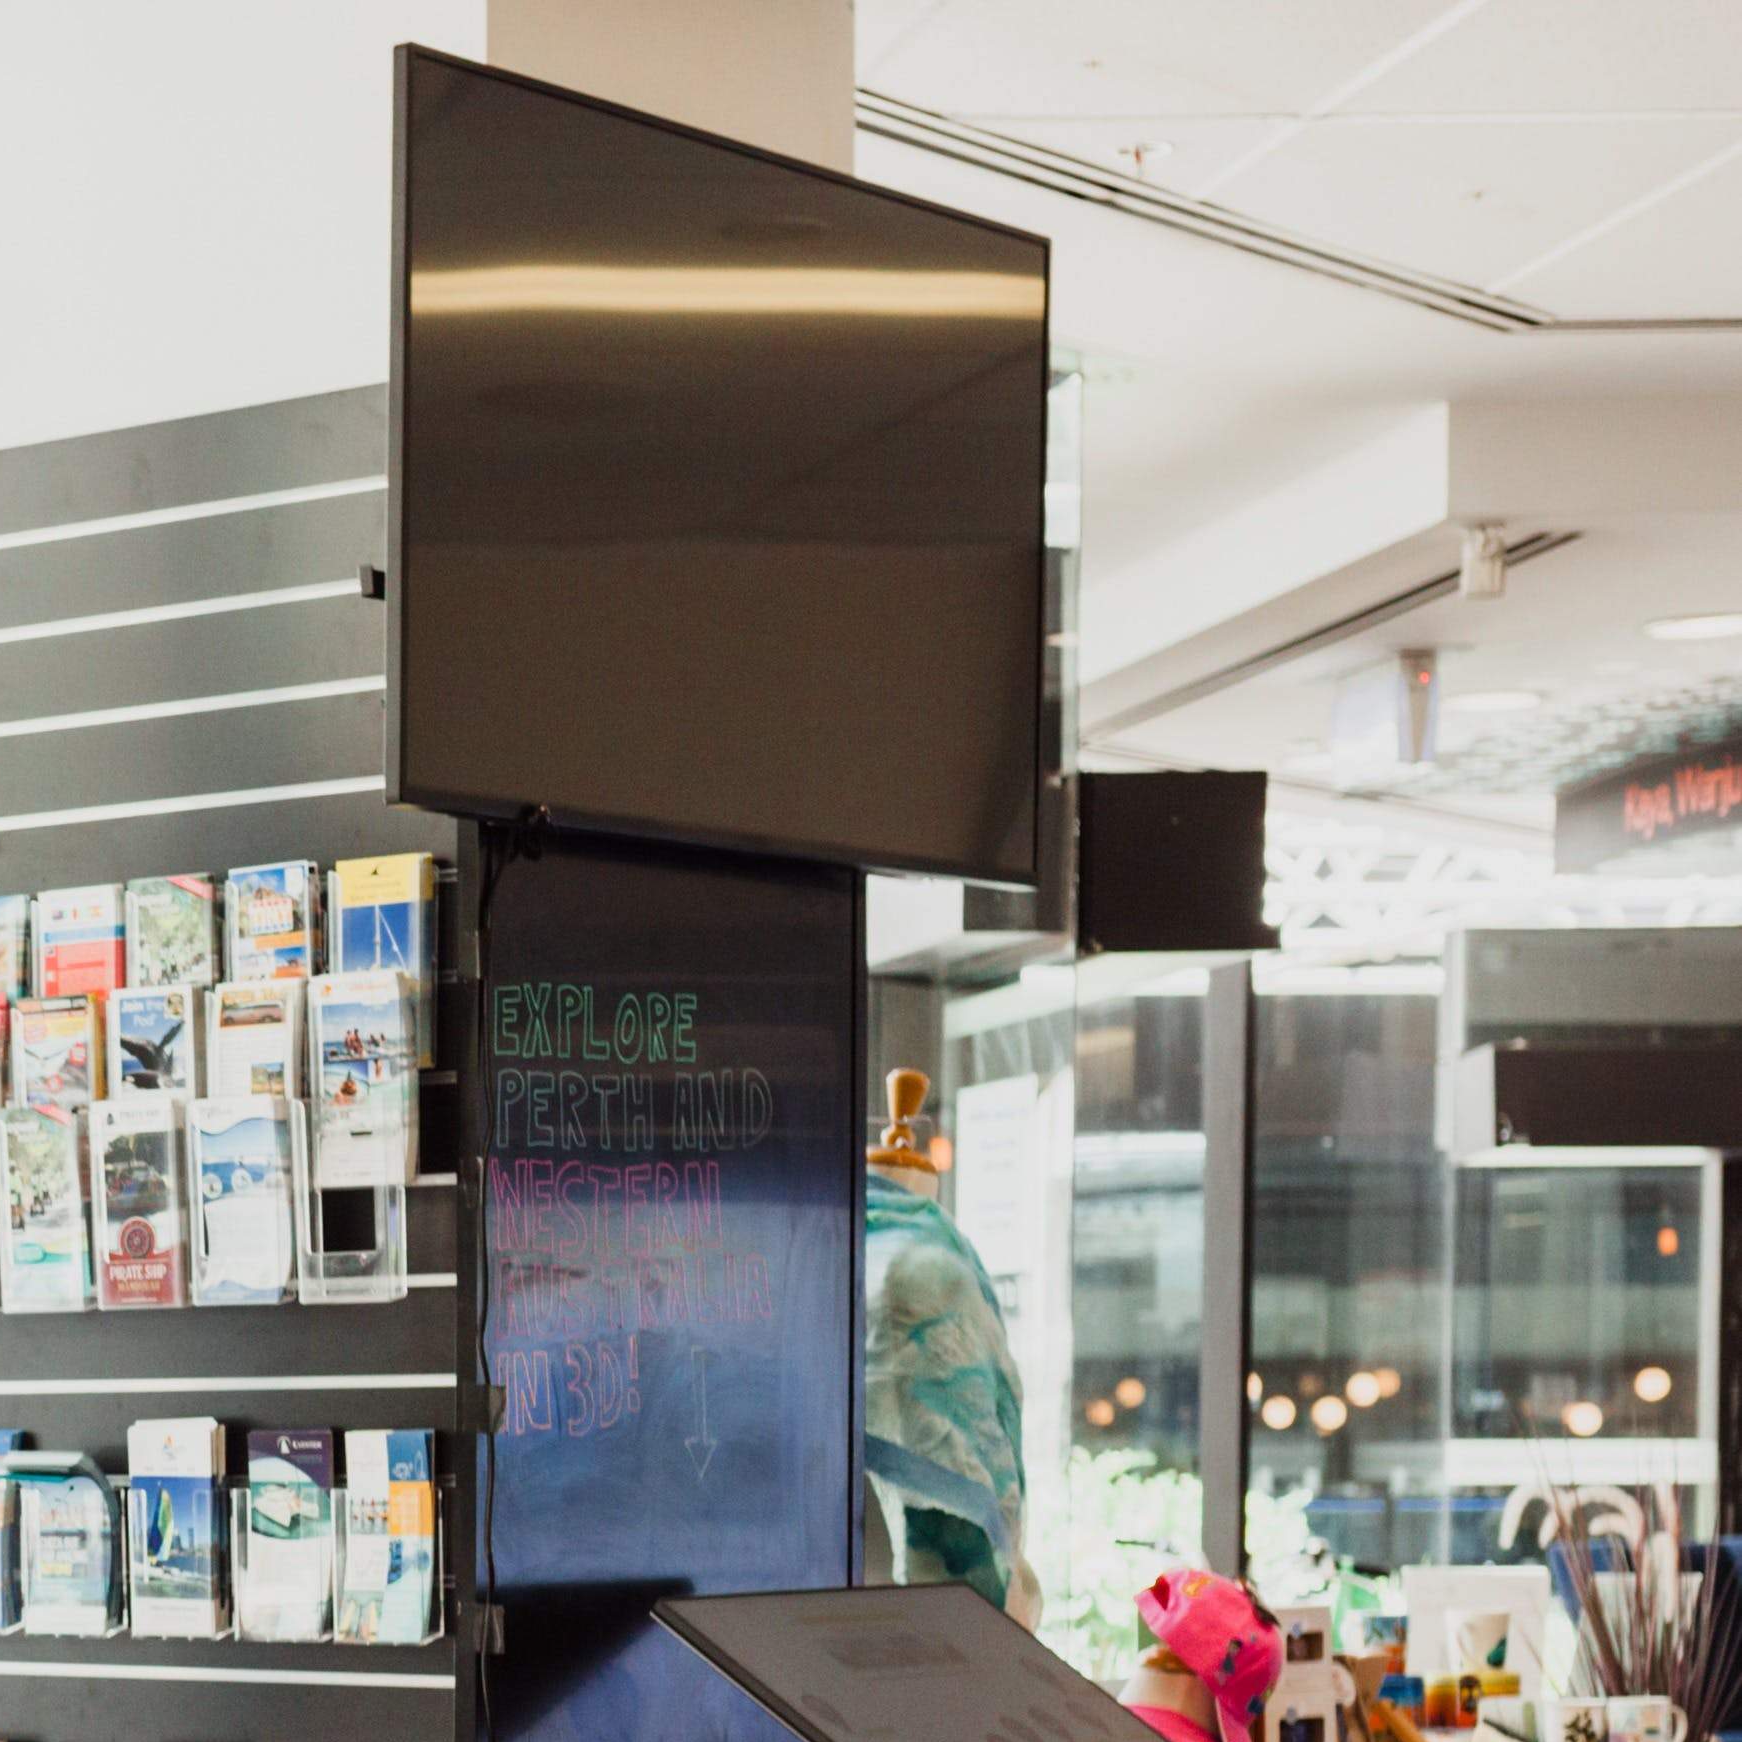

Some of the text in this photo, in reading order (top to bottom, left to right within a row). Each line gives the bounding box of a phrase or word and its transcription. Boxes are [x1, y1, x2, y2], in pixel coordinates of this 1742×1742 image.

[492, 981, 698, 1066] EXPLORE
[494, 1066, 773, 1153] PERTH AND
[490, 1158, 723, 1259] WESTERN
[110, 1263, 167, 1280] PIRATE SHIP
[494, 1252, 773, 1341] AUSTRALIA
[494, 1334, 641, 1438] IN 3D!
